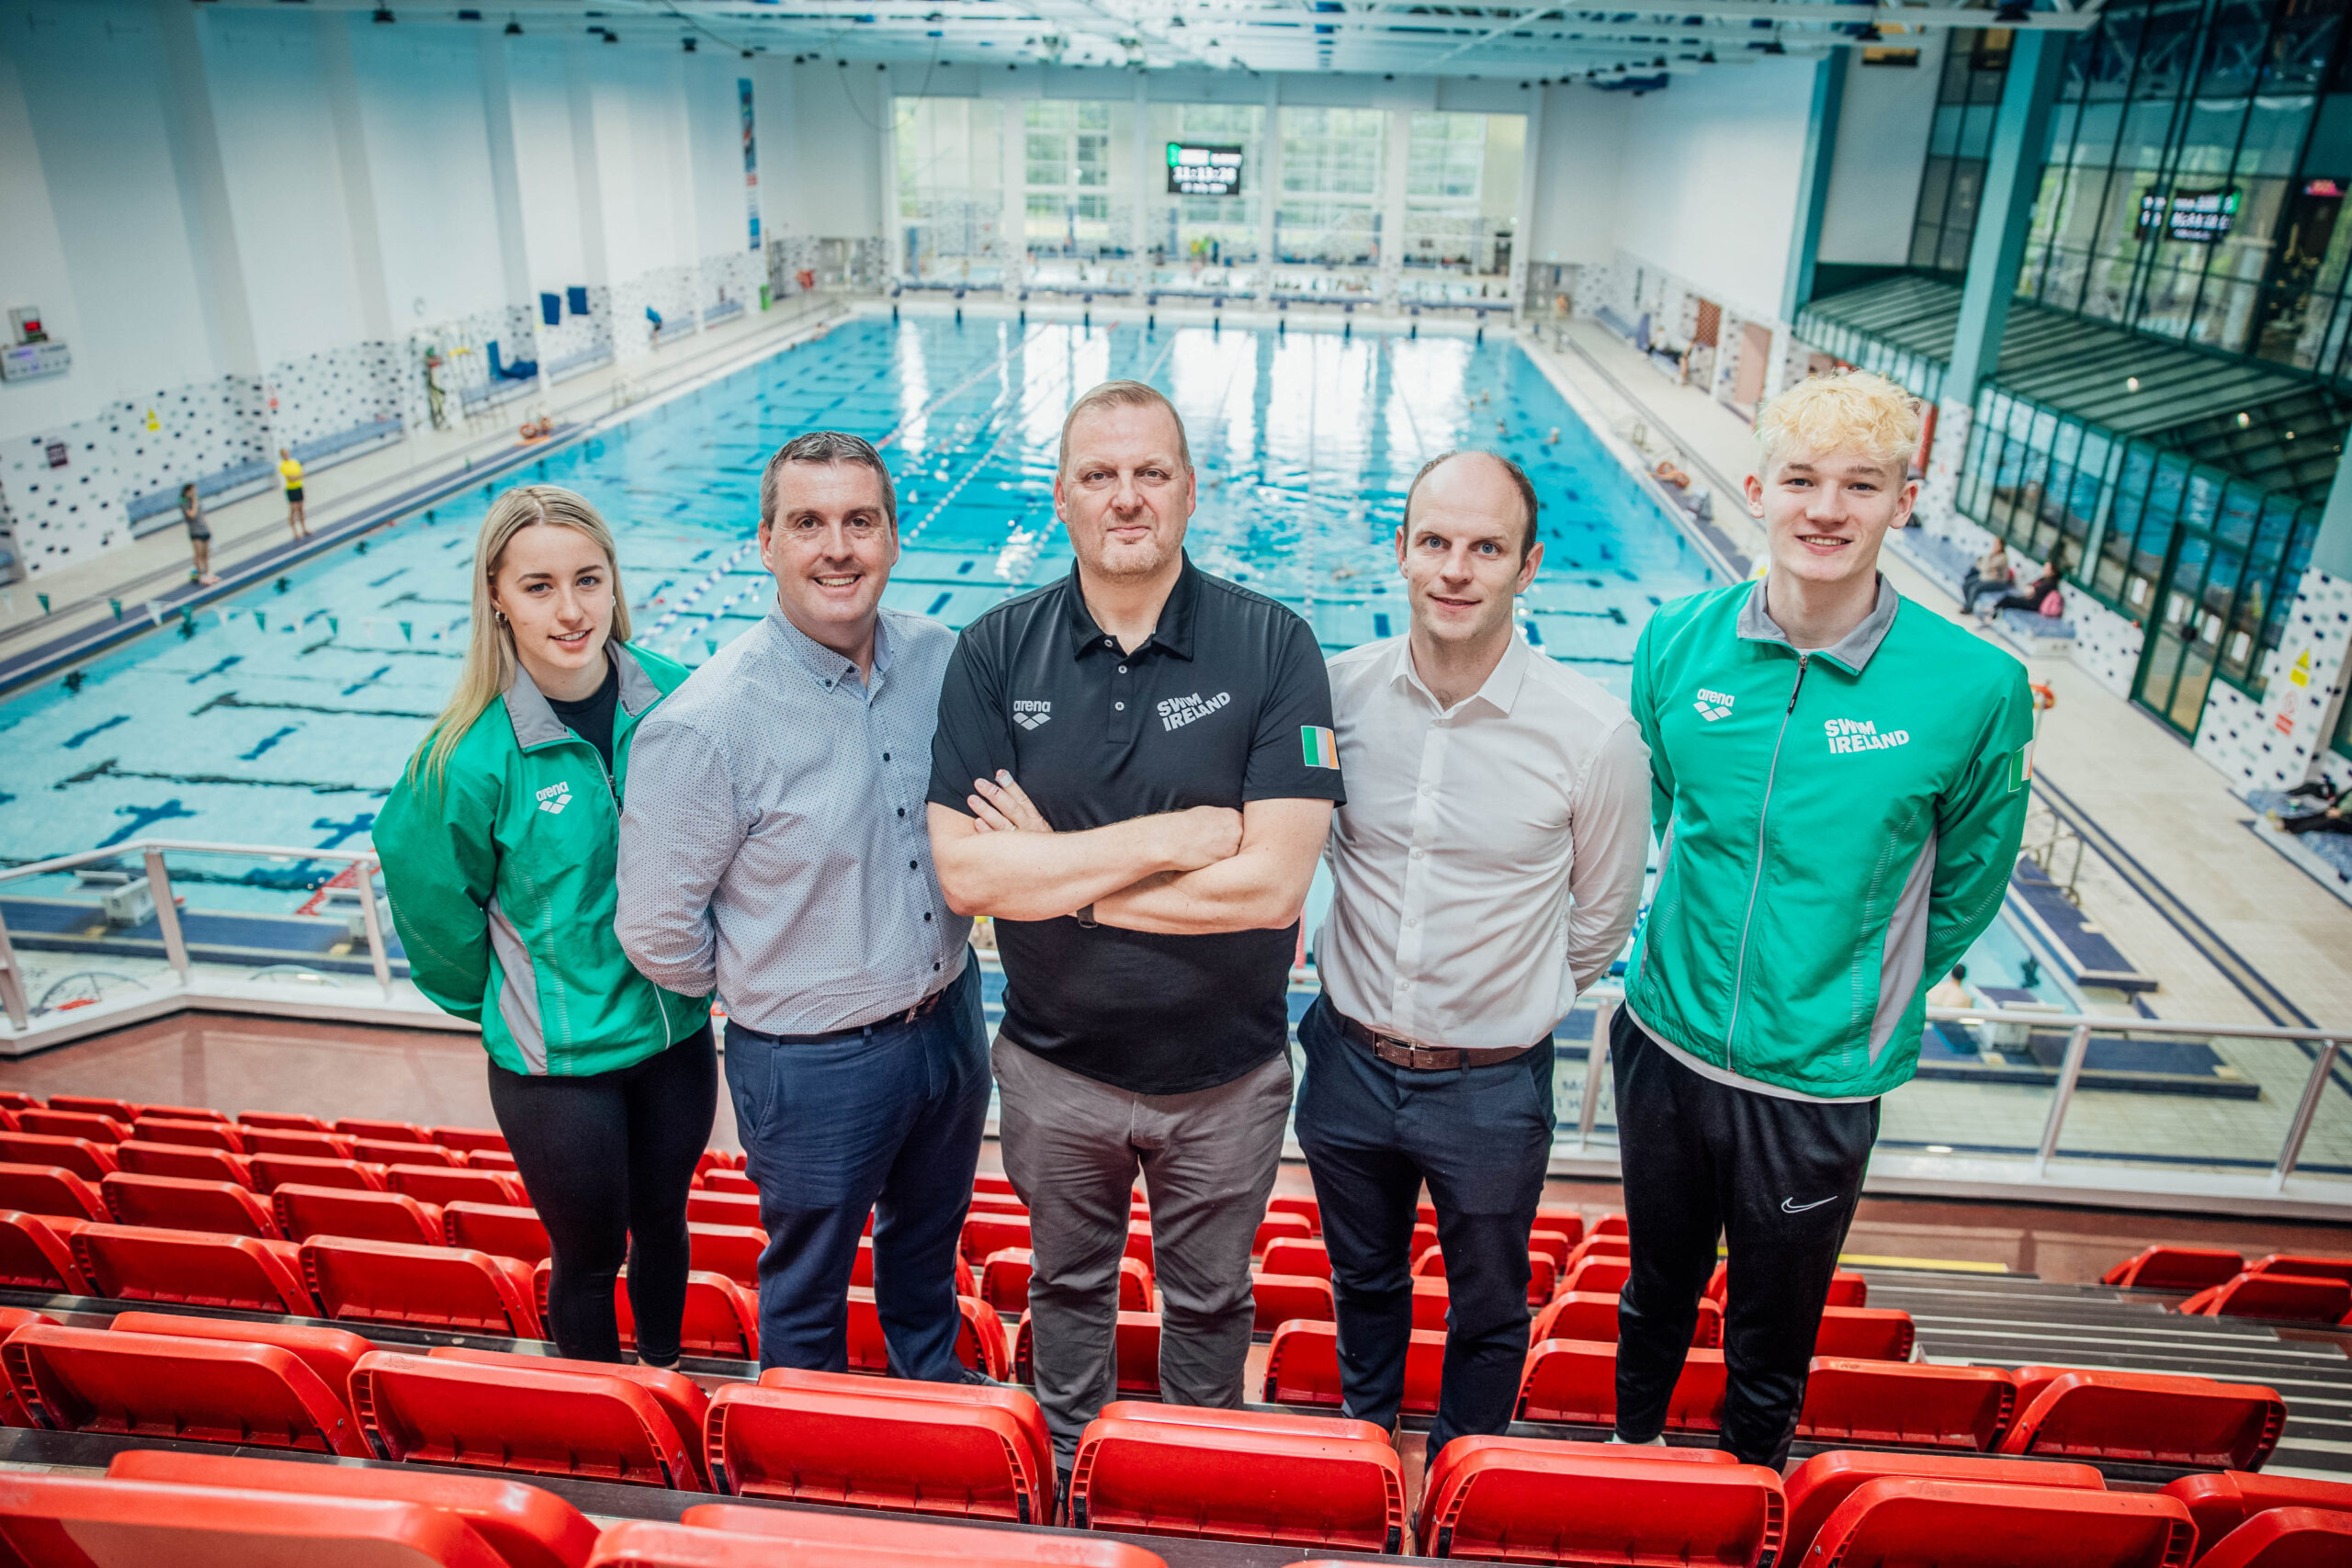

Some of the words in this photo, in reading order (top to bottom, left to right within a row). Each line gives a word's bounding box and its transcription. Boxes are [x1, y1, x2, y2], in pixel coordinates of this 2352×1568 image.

[1013, 700, 1051, 712] arena
[1158, 693, 1203, 716] SWIM
[1697, 688, 1735, 706] arena
[1162, 692, 1230, 731] IRELAND
[1824, 718, 1877, 737] SWIM
[1828, 730, 1909, 753] IRELAND
[536, 781, 570, 801] arena
